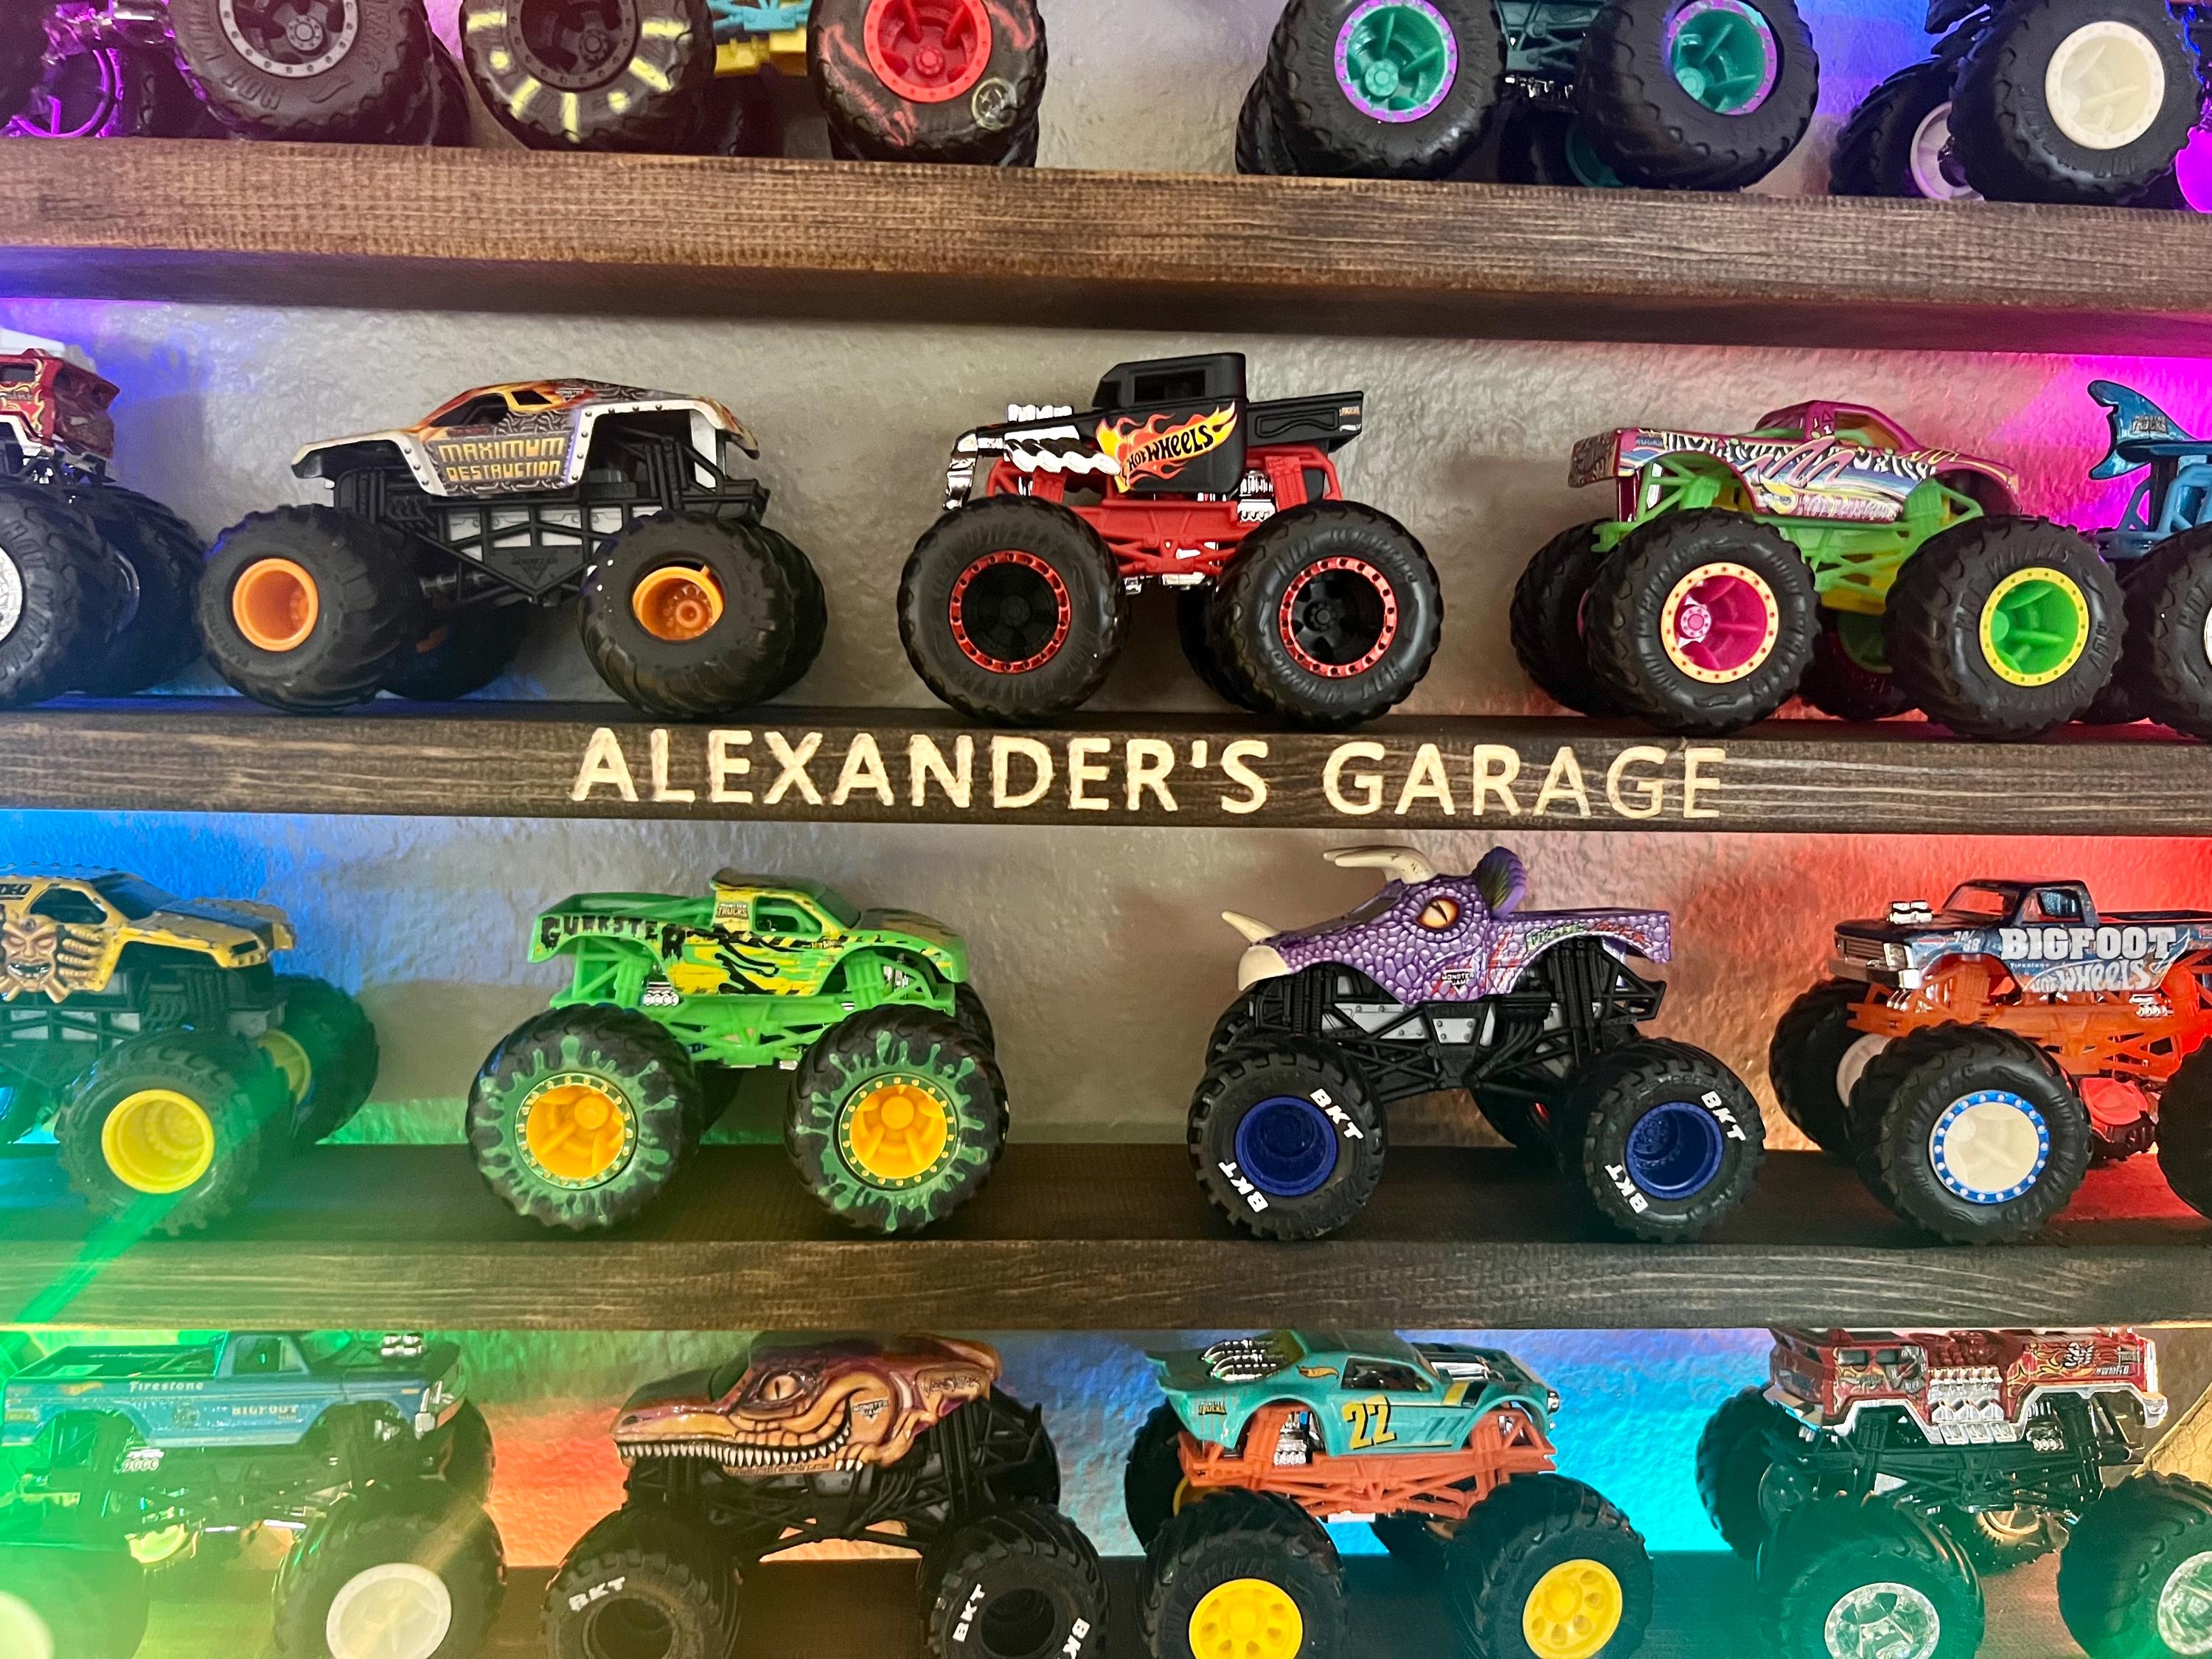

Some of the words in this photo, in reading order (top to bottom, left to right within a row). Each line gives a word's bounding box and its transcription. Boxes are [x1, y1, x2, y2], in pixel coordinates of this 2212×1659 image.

[438, 437, 565, 463] MAXIMUM
[1126, 451, 1147, 472] HOT
[446, 460, 561, 483] DESTRUCTION
[571, 726, 1270, 815] ALEXANDER'S
[1322, 740, 1727, 820] GARAGE
[718, 908, 748, 917] TRUCKS
[1998, 927, 2177, 961] BIGFOOT
[1310, 1088, 1364, 1139] BKT
[1701, 1091, 1746, 1141] BKT
[1218, 1161, 1269, 1213] BKT
[1604, 1164, 1649, 1214] BKT
[129, 1380, 204, 1393] Firestone
[232, 1404, 299, 1416] BIGFOOT
[1341, 1394, 1397, 1450] 22
[569, 1576, 626, 1613] BKT
[953, 1583, 986, 1643] BKT
[1058, 1617, 1091, 1659] BK
